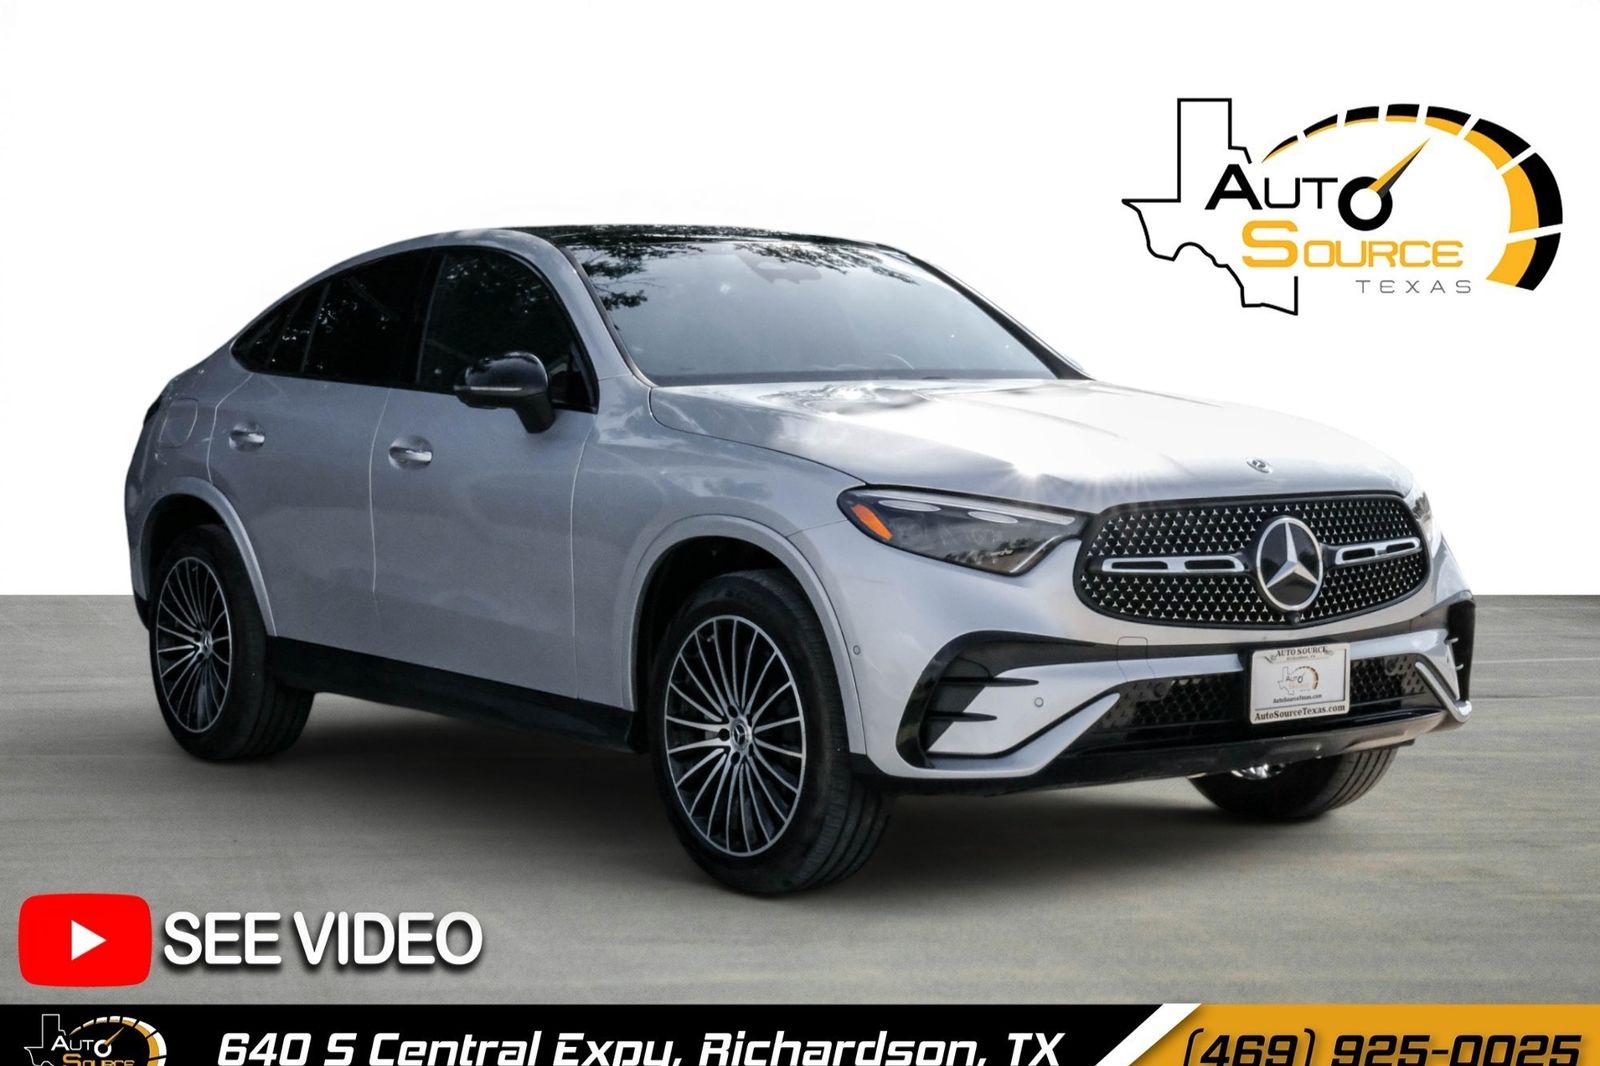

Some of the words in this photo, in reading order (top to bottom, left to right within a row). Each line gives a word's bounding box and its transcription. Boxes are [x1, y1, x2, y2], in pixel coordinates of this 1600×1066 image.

[1276, 649, 1296, 657] AUTO
[1297, 646, 1327, 655] SOURCE
[1255, 705, 1345, 720] AutoSourceTexas.com
